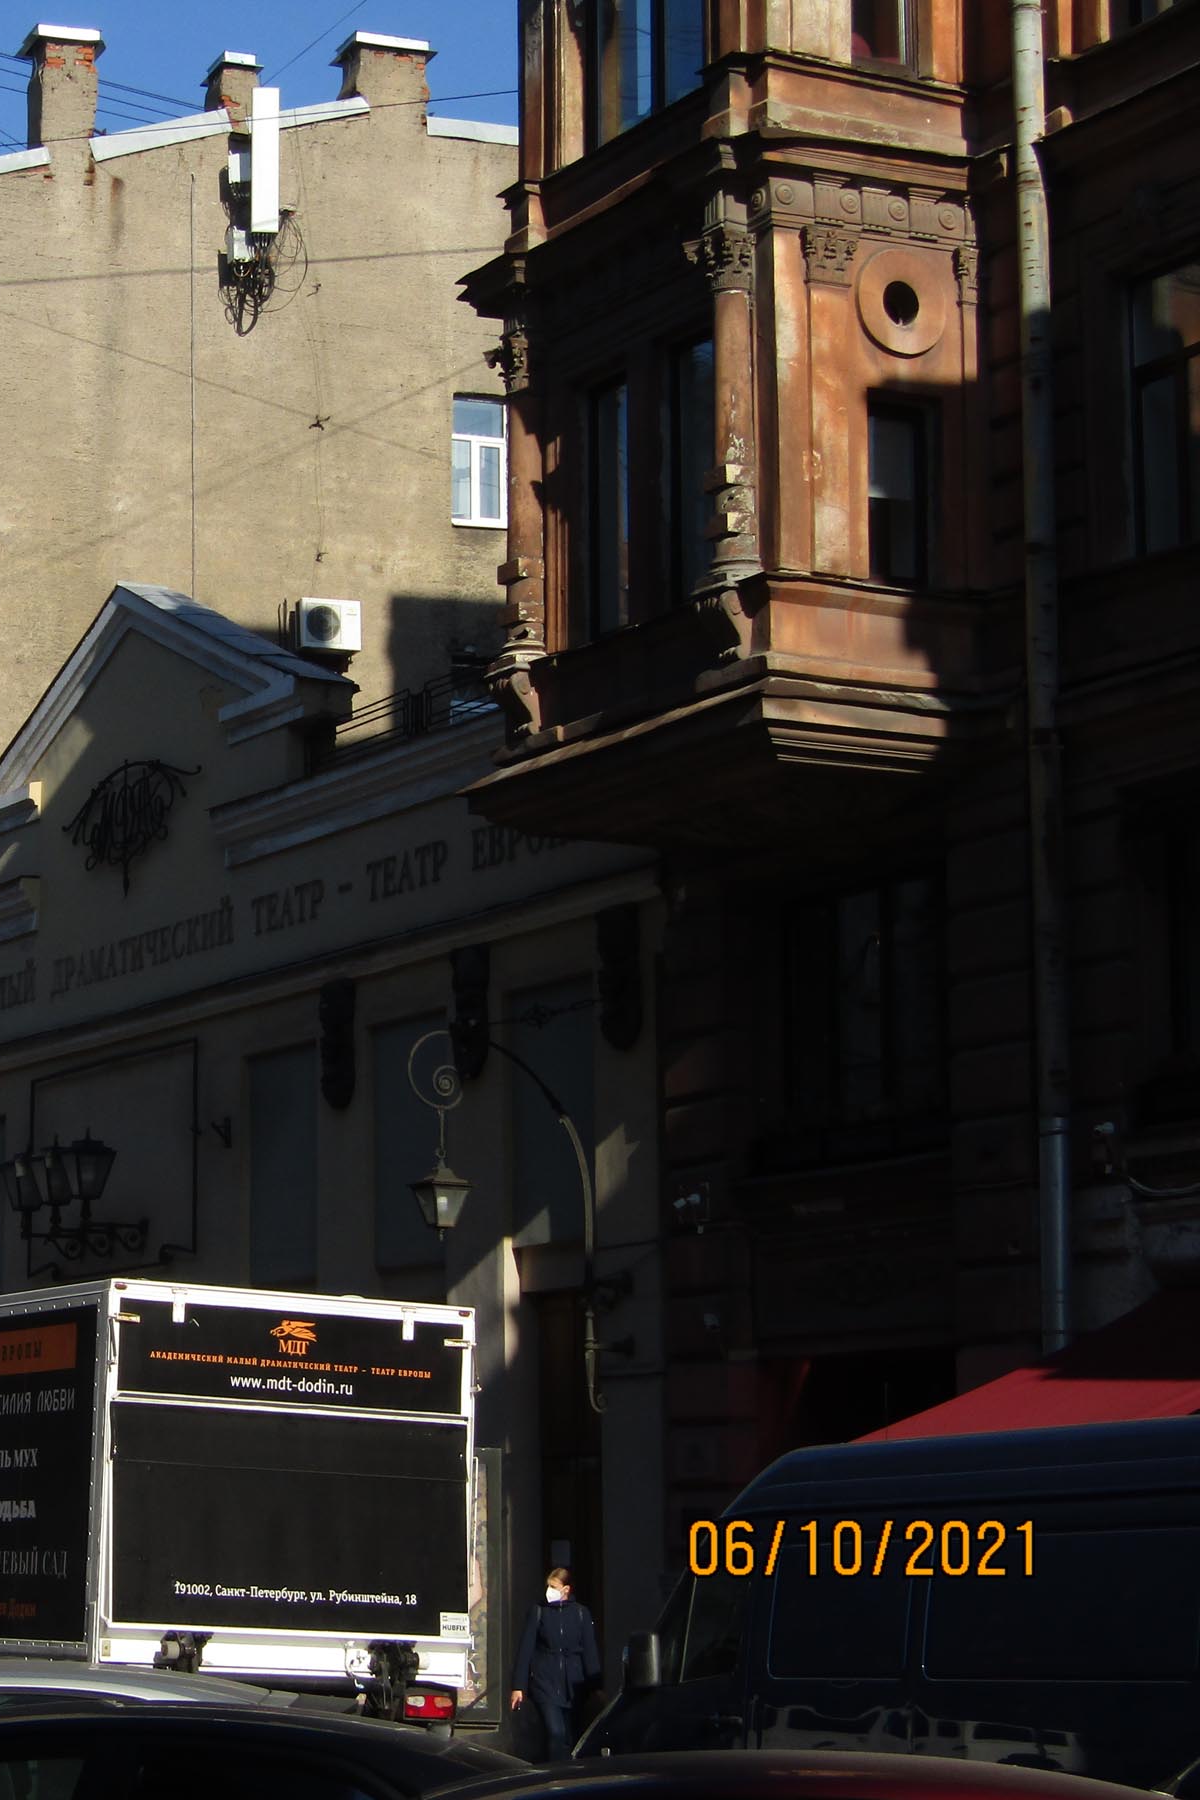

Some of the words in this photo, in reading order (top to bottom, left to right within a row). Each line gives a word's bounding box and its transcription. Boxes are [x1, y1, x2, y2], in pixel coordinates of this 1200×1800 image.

[50, 900, 234, 999] ДРАМАТИЧЕСКИЙ
[251, 879, 326, 937] ТЕАТР
[366, 840, 448, 901] ТЕАТР
[150, 1350, 224, 1364] АКАДЕМИЧЕСКИЙ
[226, 1356, 258, 1366] МАЛЫЙ
[260, 1358, 331, 1372] ДРАМАТИЧЕСКИЙ
[334, 1364, 359, 1374] ТЕАТР
[371, 1367, 396, 1378] ТЕАТР
[398, 1369, 432, 1379] ЕВРОПЫ
[230, 1374, 353, 1396] www.mdt-dodin.ru
[37, 1387, 75, 1413] ЛЮБВИ
[14, 1448, 38, 1468] МУХ
[43, 1551, 68, 1578] САД
[175, 1581, 213, 1597] 191002,
[215, 1584, 308, 1602] Санкт-Петербург,
[310, 1591, 326, 1604] ул.
[329, 1589, 402, 1606] Рубинштейна,
[405, 1594, 417, 1605] 18
